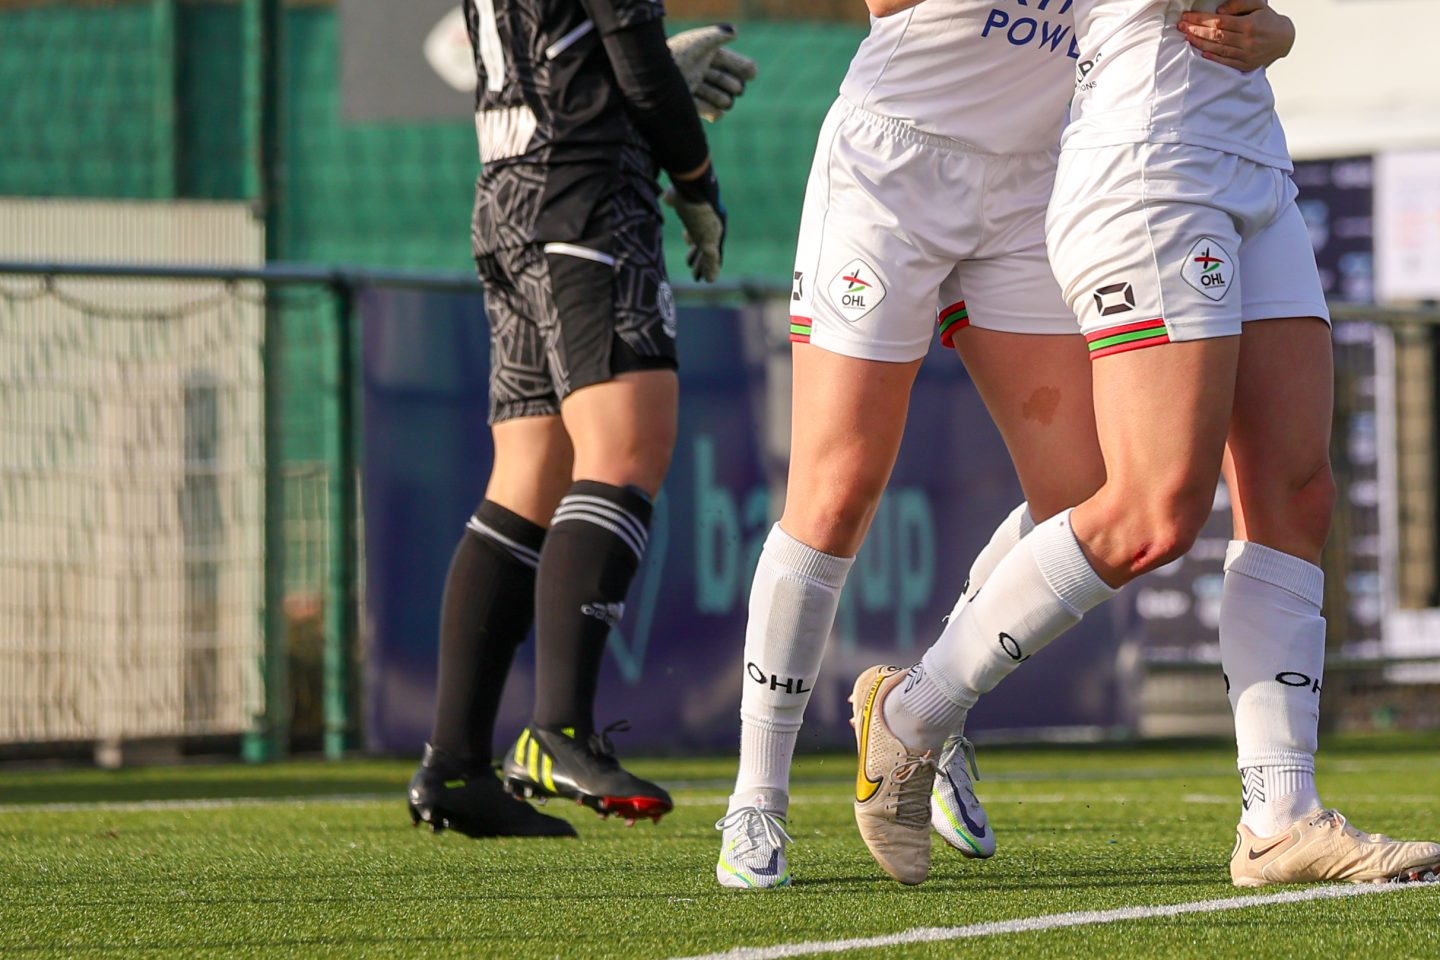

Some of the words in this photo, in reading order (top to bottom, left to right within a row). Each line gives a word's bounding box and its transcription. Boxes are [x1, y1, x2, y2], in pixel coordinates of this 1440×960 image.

[1200, 273, 1226, 287] OHL
[841, 294, 866, 308] OHL
[747, 662, 811, 695] OHL
